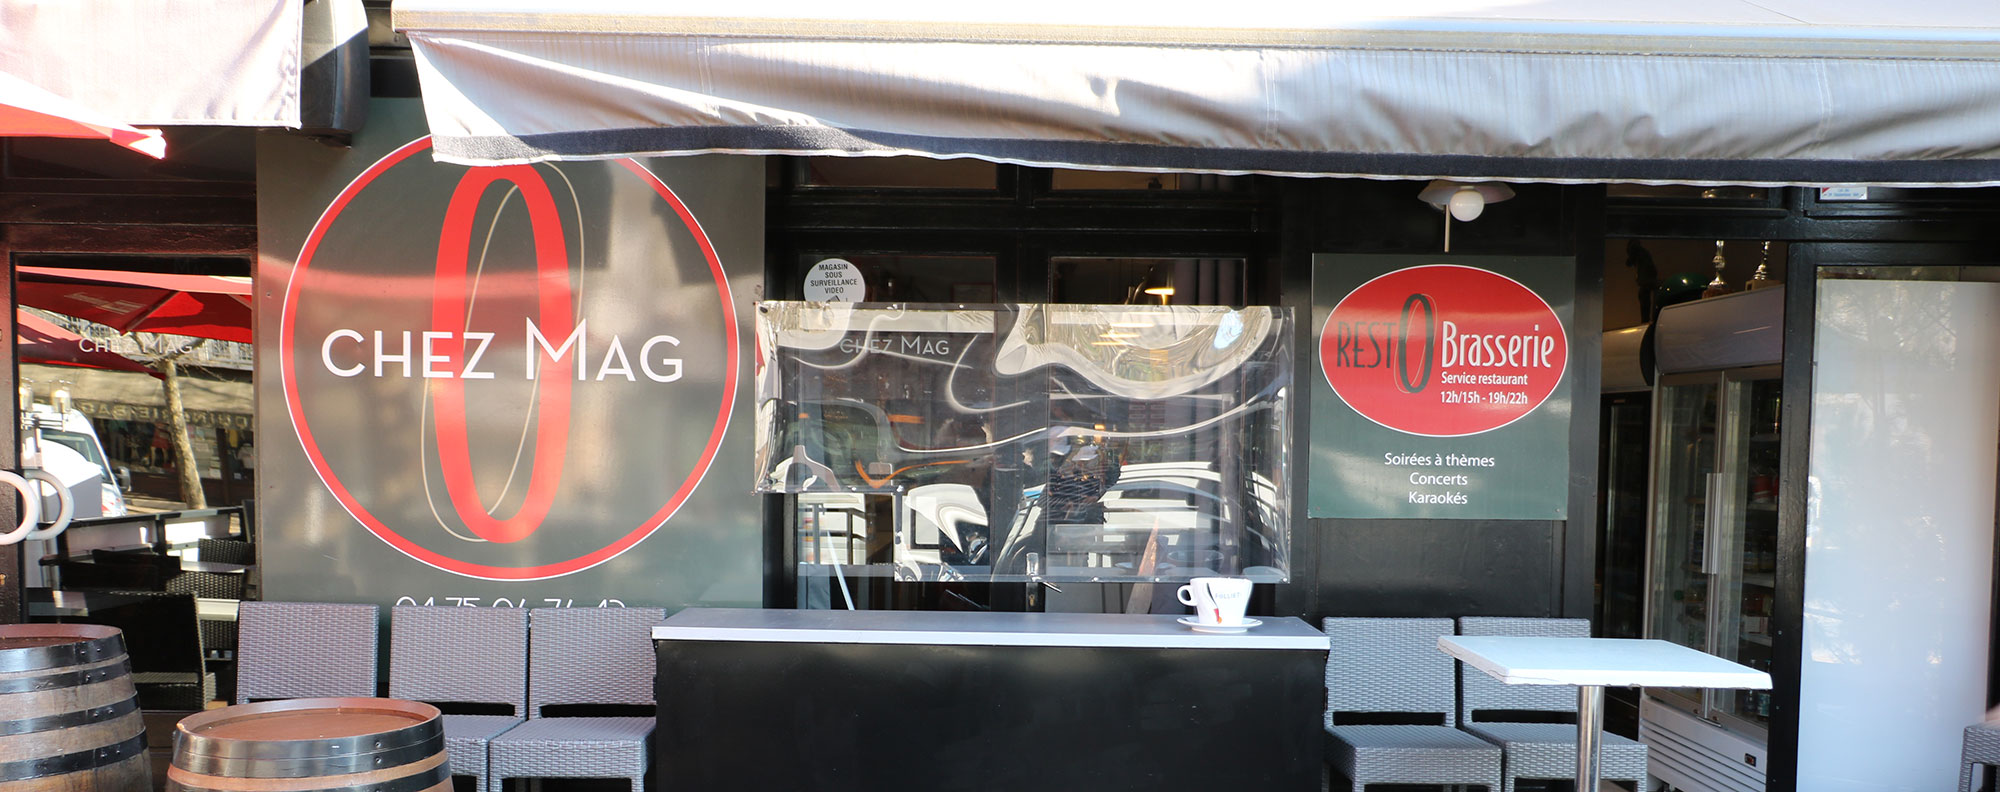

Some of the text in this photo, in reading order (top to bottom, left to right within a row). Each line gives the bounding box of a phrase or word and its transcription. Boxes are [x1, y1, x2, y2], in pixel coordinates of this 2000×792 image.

[818, 263, 848, 271] MAGASIN
[810, 278, 857, 286] SURVEILLANCE
[824, 286, 844, 294] VIDEO
[78, 335, 194, 354] CHEZ MAG
[321, 316, 684, 383] CHEZ MAG
[839, 334, 950, 356] CHEZ MAG
[1441, 320, 1555, 368] Brasserie
[1441, 371, 1529, 386] Service restaurant
[1440, 390, 1480, 405] 12h/15h
[1488, 391, 1529, 406] 19h/22h
[1384, 452, 1495, 468] Soirées à thèmes
[1409, 471, 1468, 486] Concerts
[1408, 491, 1468, 505] Karaokés
